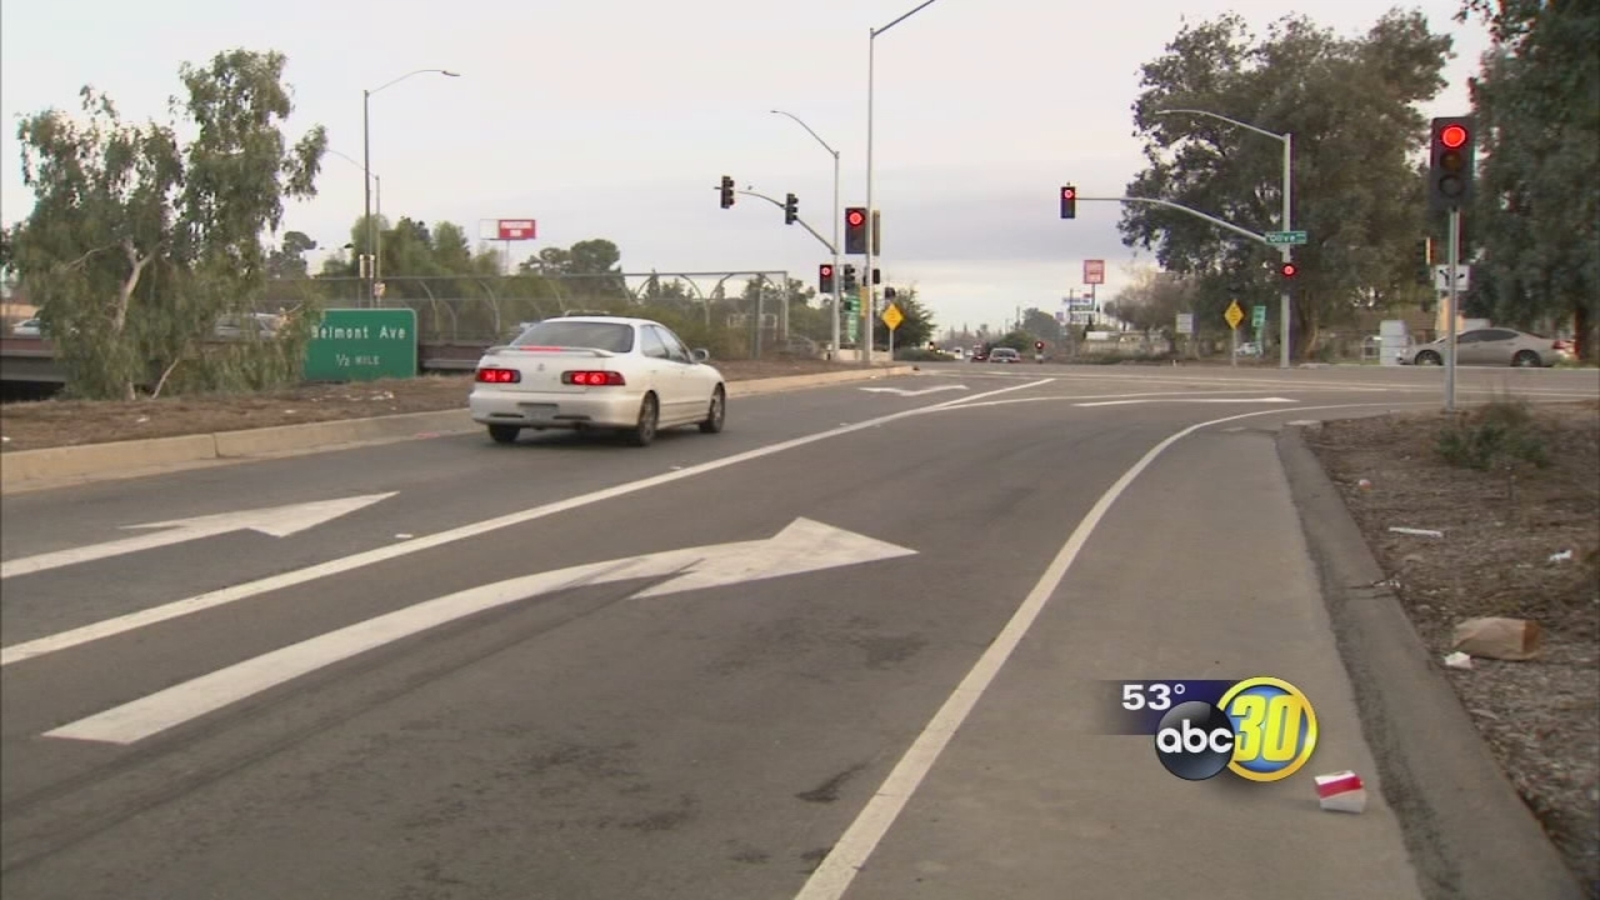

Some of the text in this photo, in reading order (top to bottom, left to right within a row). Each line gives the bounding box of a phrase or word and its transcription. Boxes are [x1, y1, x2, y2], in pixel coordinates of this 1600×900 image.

[311, 325, 406, 339] Belmont Ave
[355, 355, 380, 366] MILE
